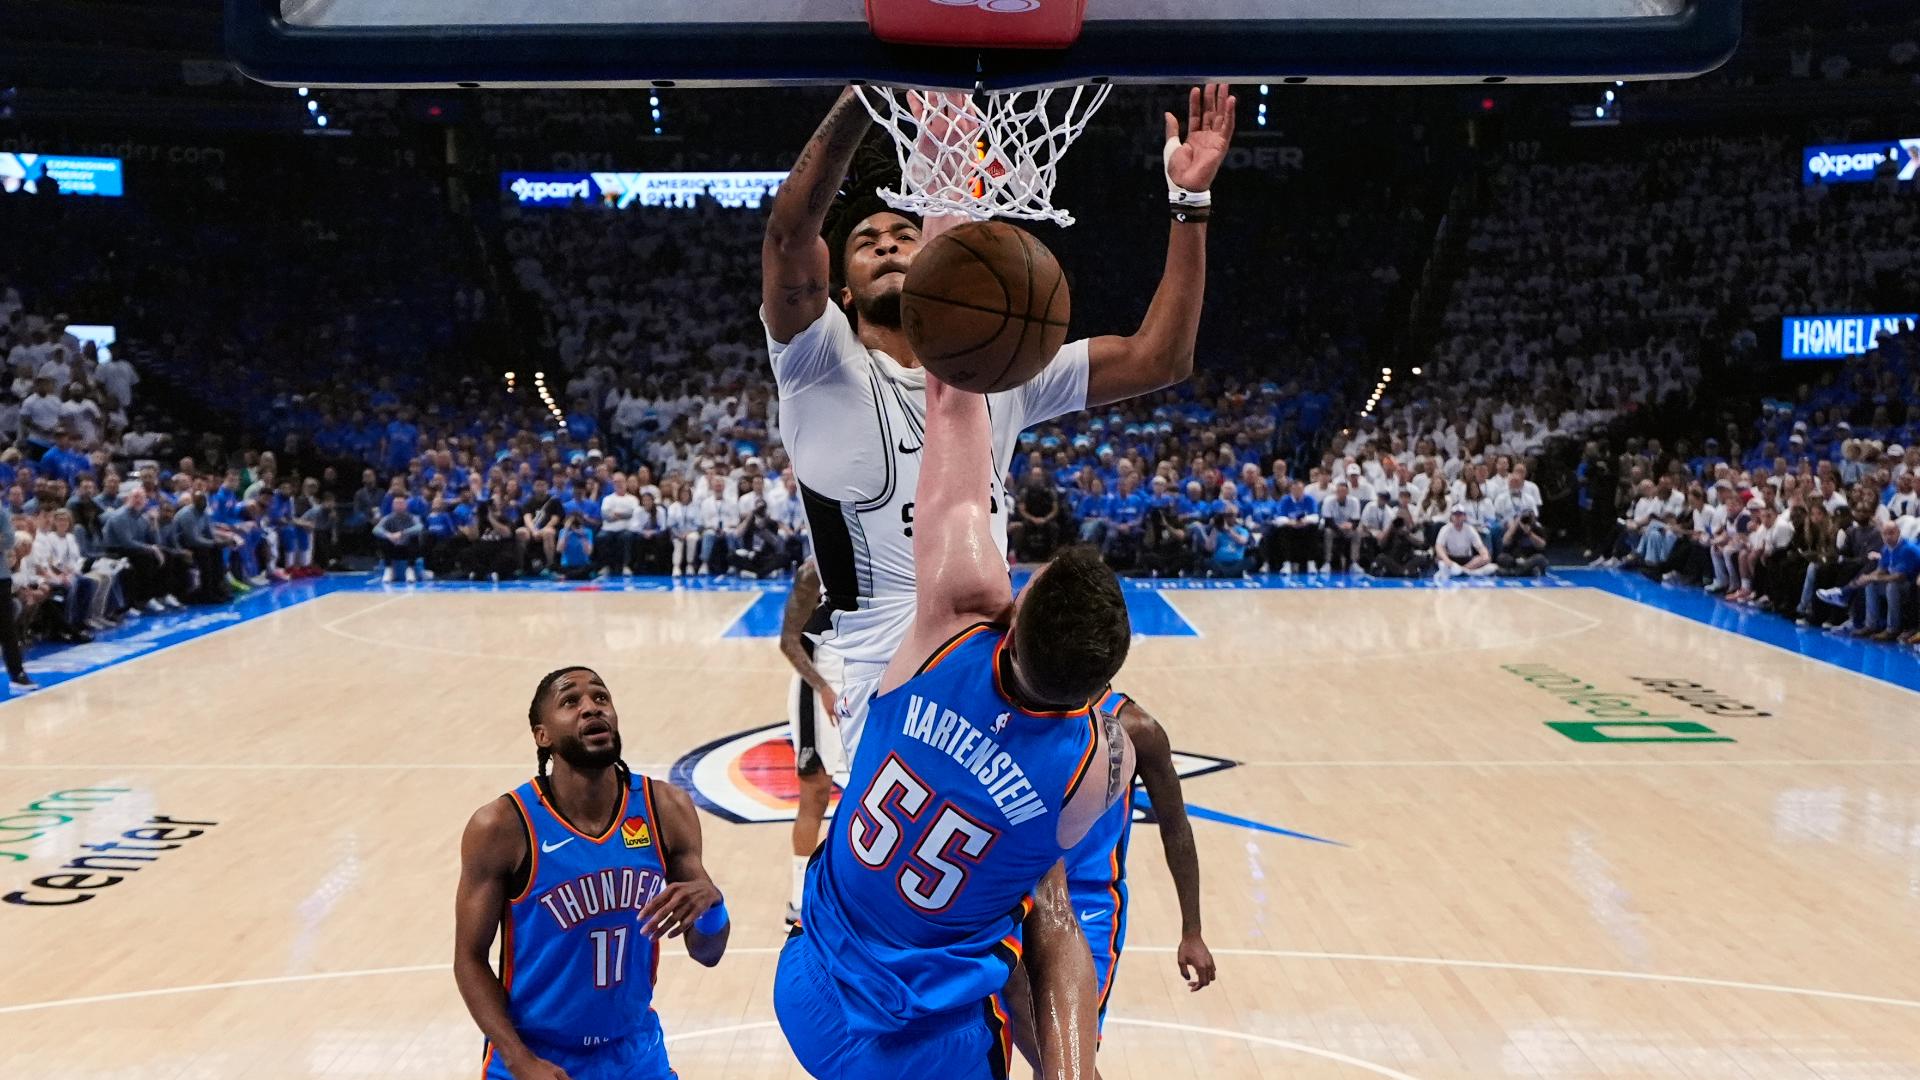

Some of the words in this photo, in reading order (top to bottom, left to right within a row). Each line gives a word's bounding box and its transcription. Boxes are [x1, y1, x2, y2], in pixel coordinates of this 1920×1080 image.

[902, 694, 1048, 827] HARTENSTEIN
[1, 815, 219, 906] center
[848, 750, 1002, 914] 55
